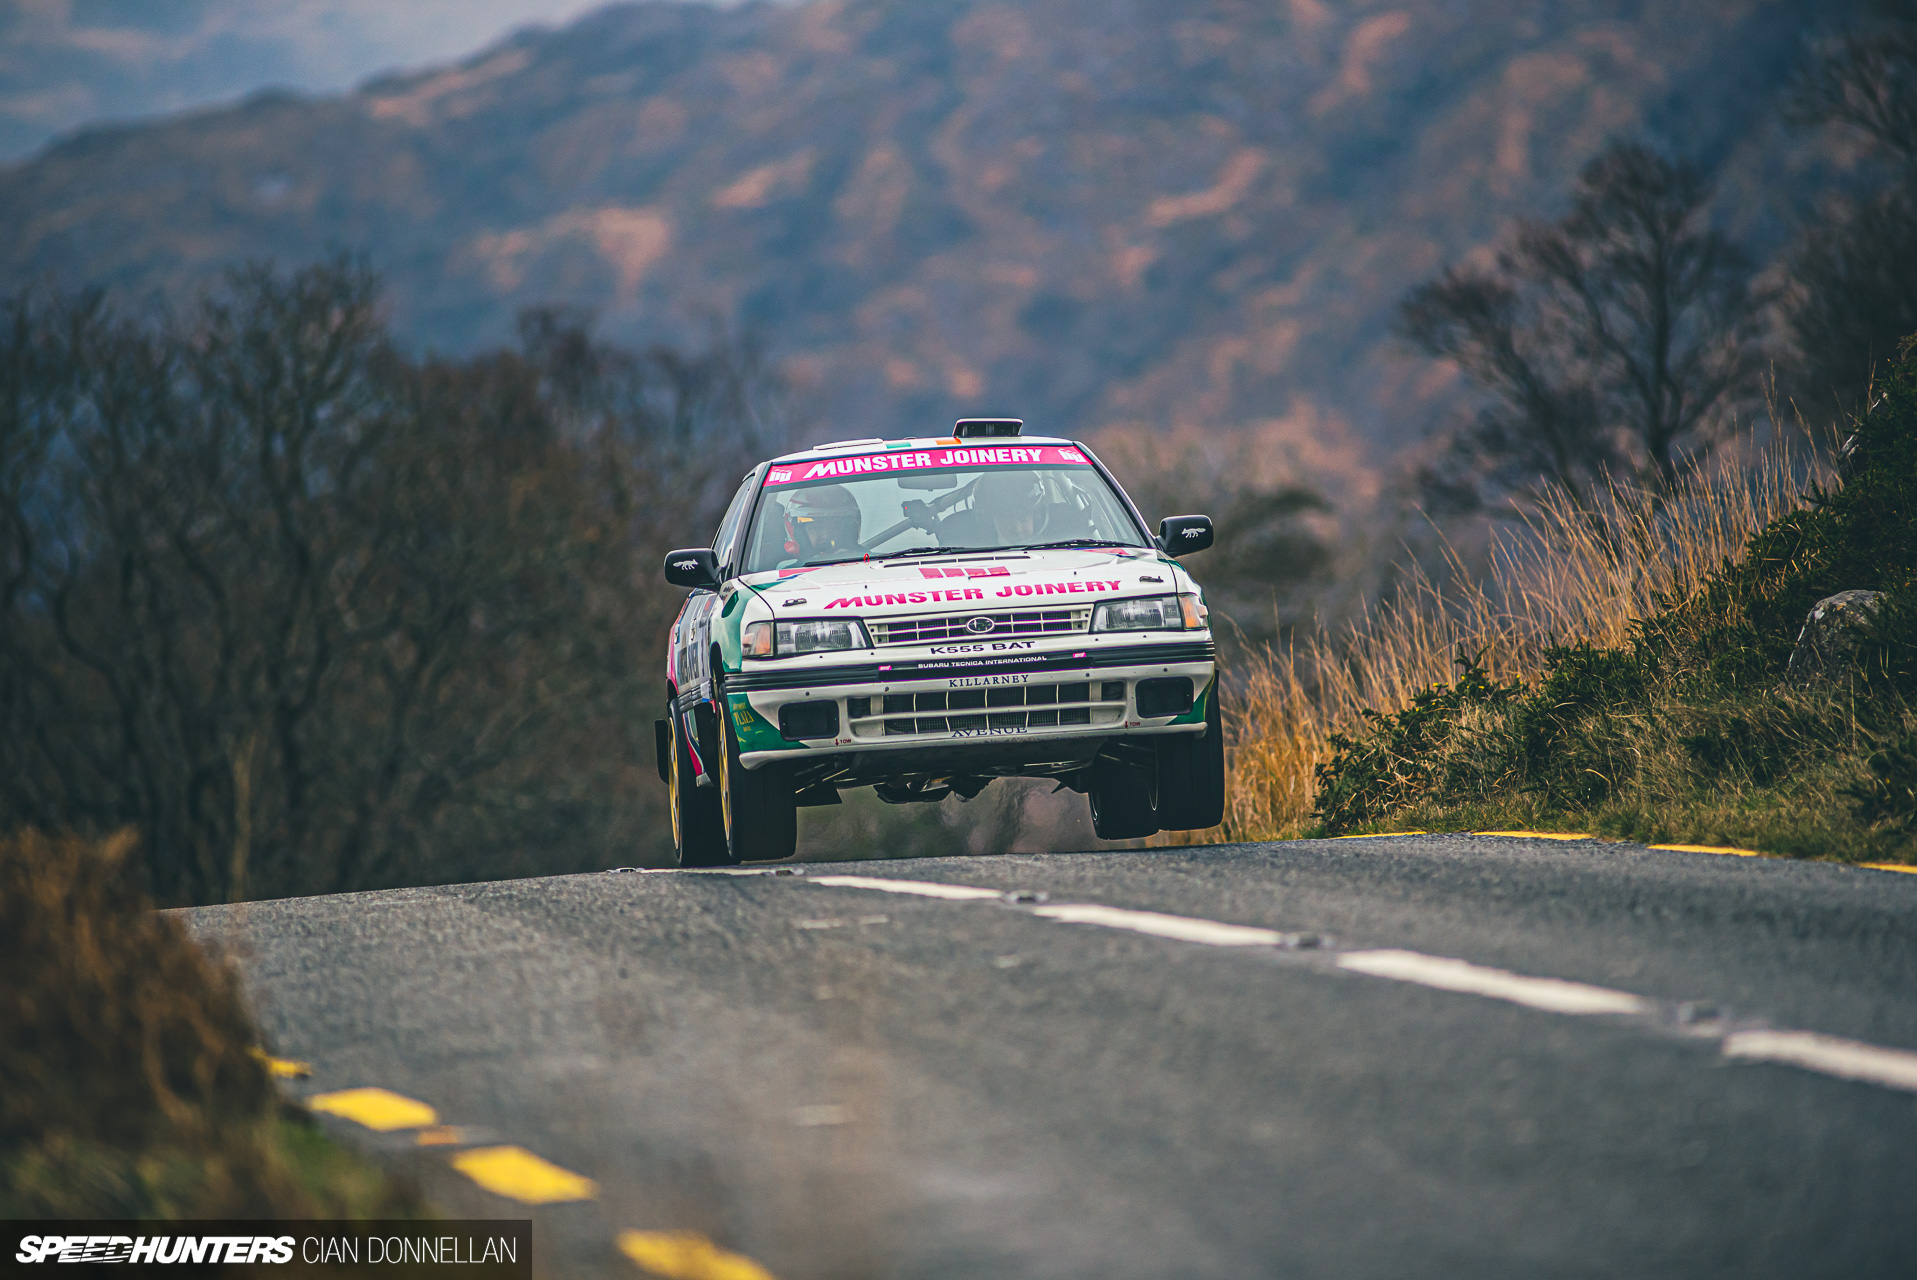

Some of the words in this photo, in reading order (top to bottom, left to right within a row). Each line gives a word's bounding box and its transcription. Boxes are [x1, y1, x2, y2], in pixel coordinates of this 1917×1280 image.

[803, 453, 931, 479] MUNSTER
[940, 449, 1043, 467] JOINERY
[823, 588, 984, 609] MUNSTER
[995, 580, 1122, 598] JOINERY
[930, 645, 984, 655] K555
[992, 641, 1036, 651] BAT
[951, 659, 984, 667] TECNICA
[985, 655, 1047, 665] INTERNATIONAL
[949, 674, 1030, 688] KILLARNEY
[951, 726, 1028, 738] AVENUE
